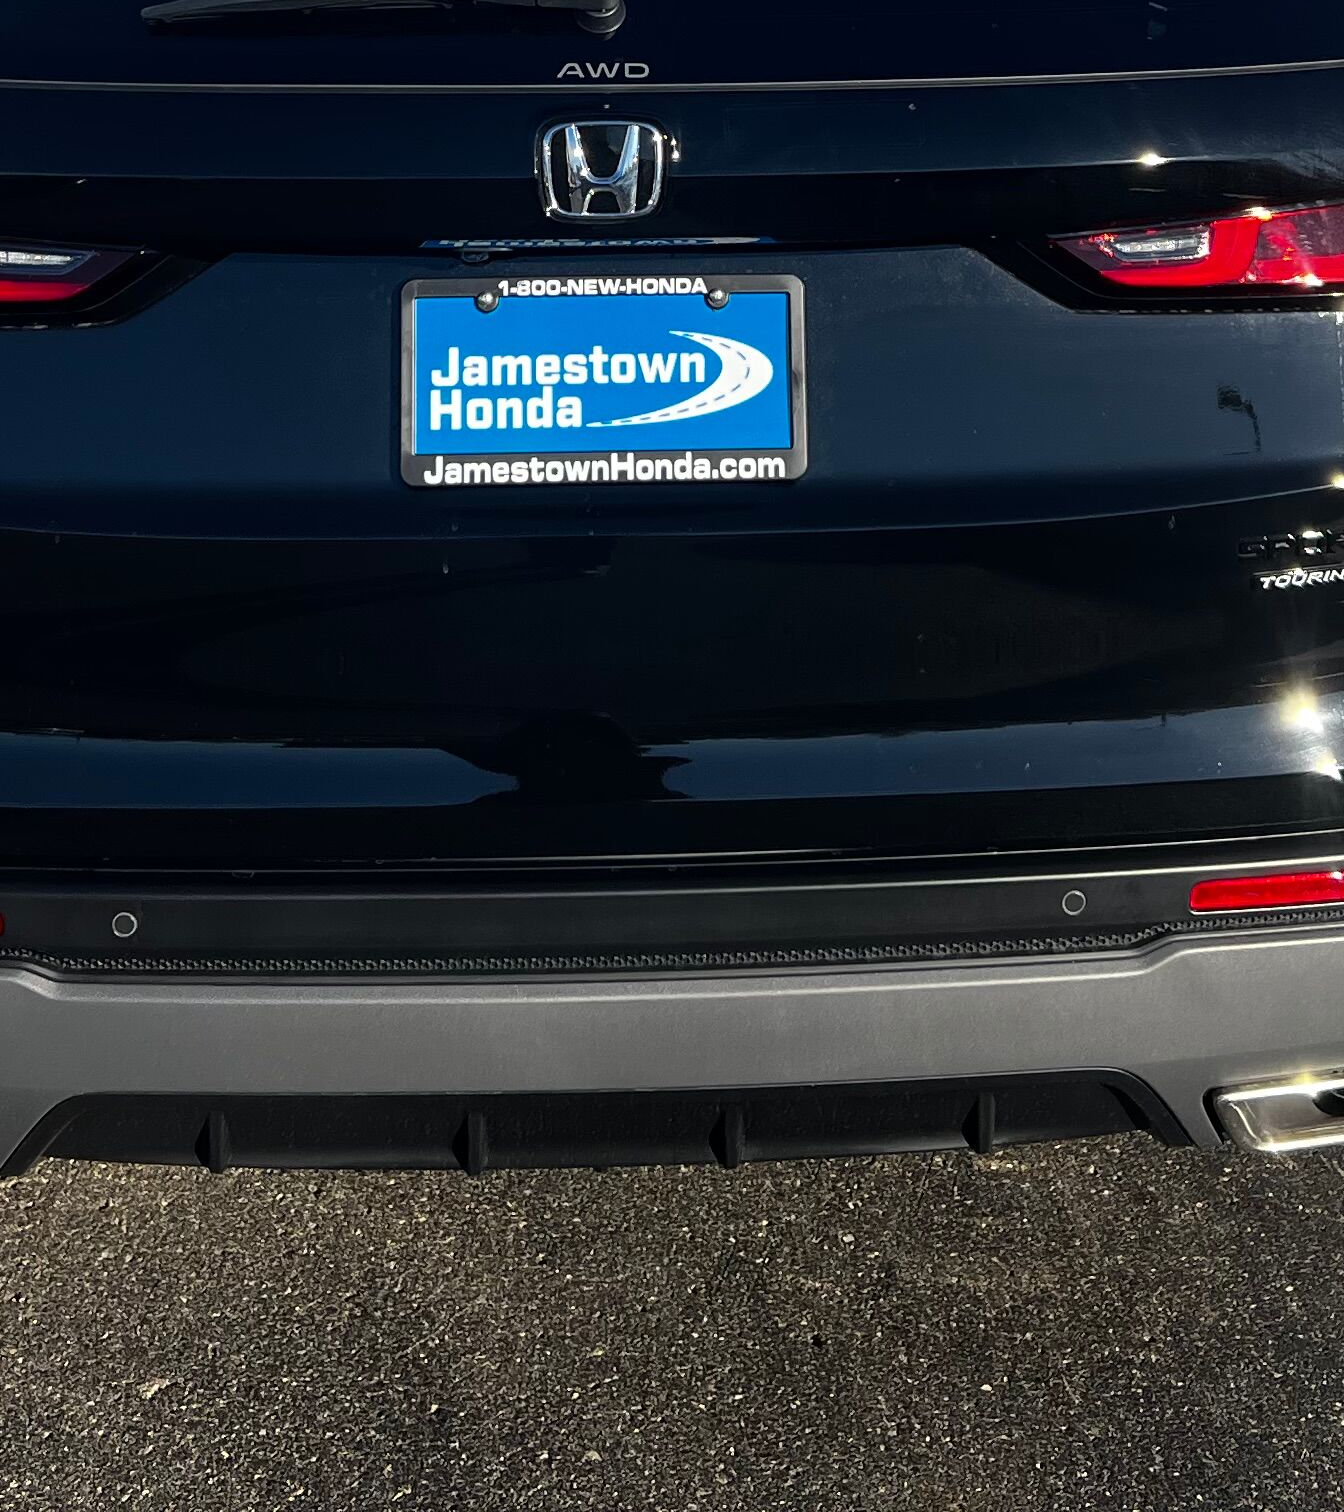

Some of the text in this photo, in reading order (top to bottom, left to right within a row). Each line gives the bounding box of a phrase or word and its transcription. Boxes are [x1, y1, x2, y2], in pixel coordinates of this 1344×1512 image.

[556, 62, 650, 79] AWD
[497, 276, 709, 298] 1-800-NEW-HONDA
[431, 345, 706, 388] Jamestown
[429, 385, 583, 431] Honda
[423, 451, 787, 485] JamestownHonda.com
